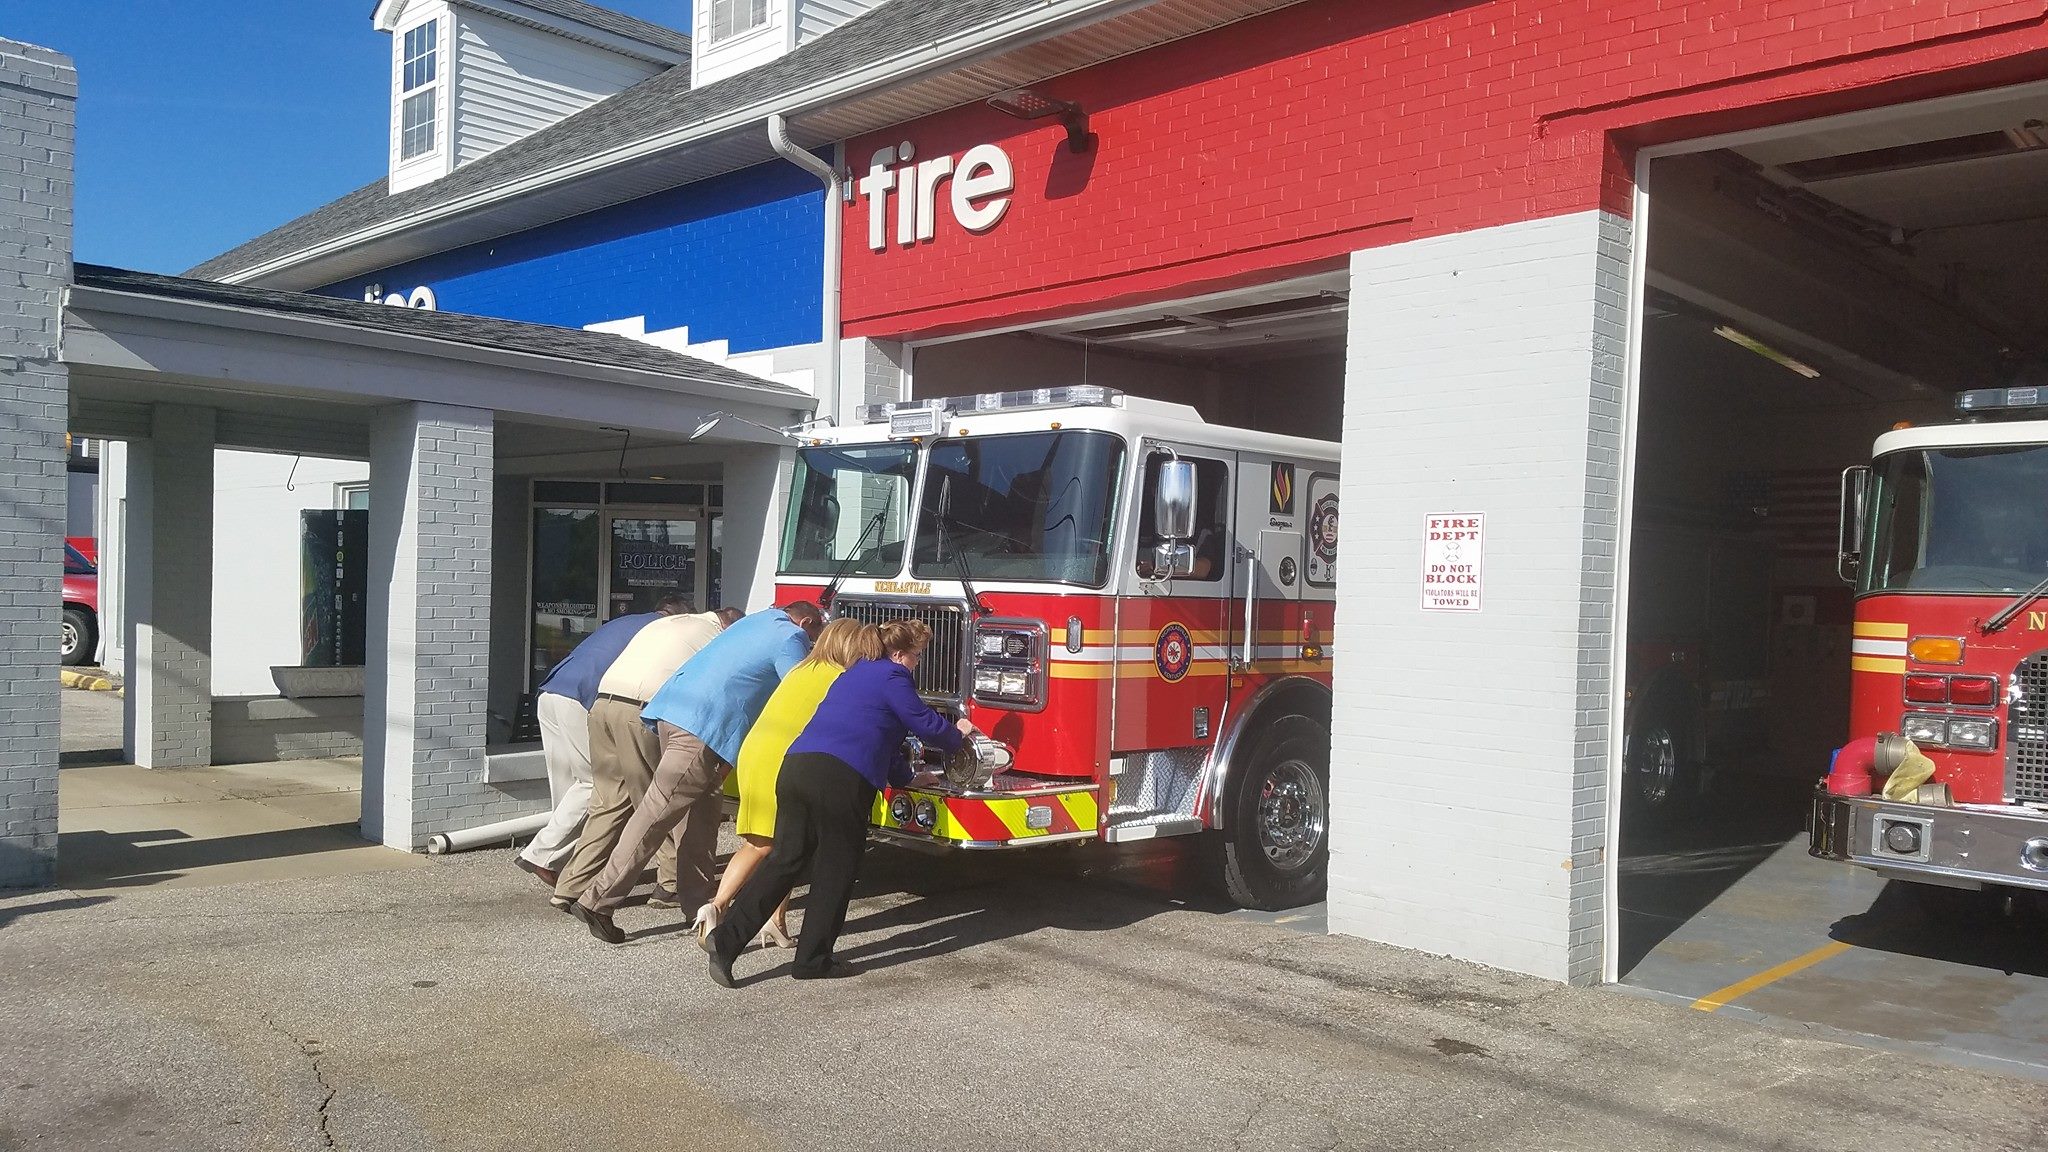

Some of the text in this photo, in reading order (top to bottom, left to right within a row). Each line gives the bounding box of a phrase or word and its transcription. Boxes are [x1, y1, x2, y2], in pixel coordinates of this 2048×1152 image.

[860, 140, 1014, 250] fire
[1430, 519, 1479, 529] FIRE
[1430, 531, 1479, 541] DEPT
[620, 552, 687, 570] POLICE
[1431, 564, 1473, 573] DO NOT
[1426, 574, 1477, 584] BLOCK
[1425, 589, 1478, 598] VIOLATORS WILL BE
[1433, 598, 1470, 606] TOWED
